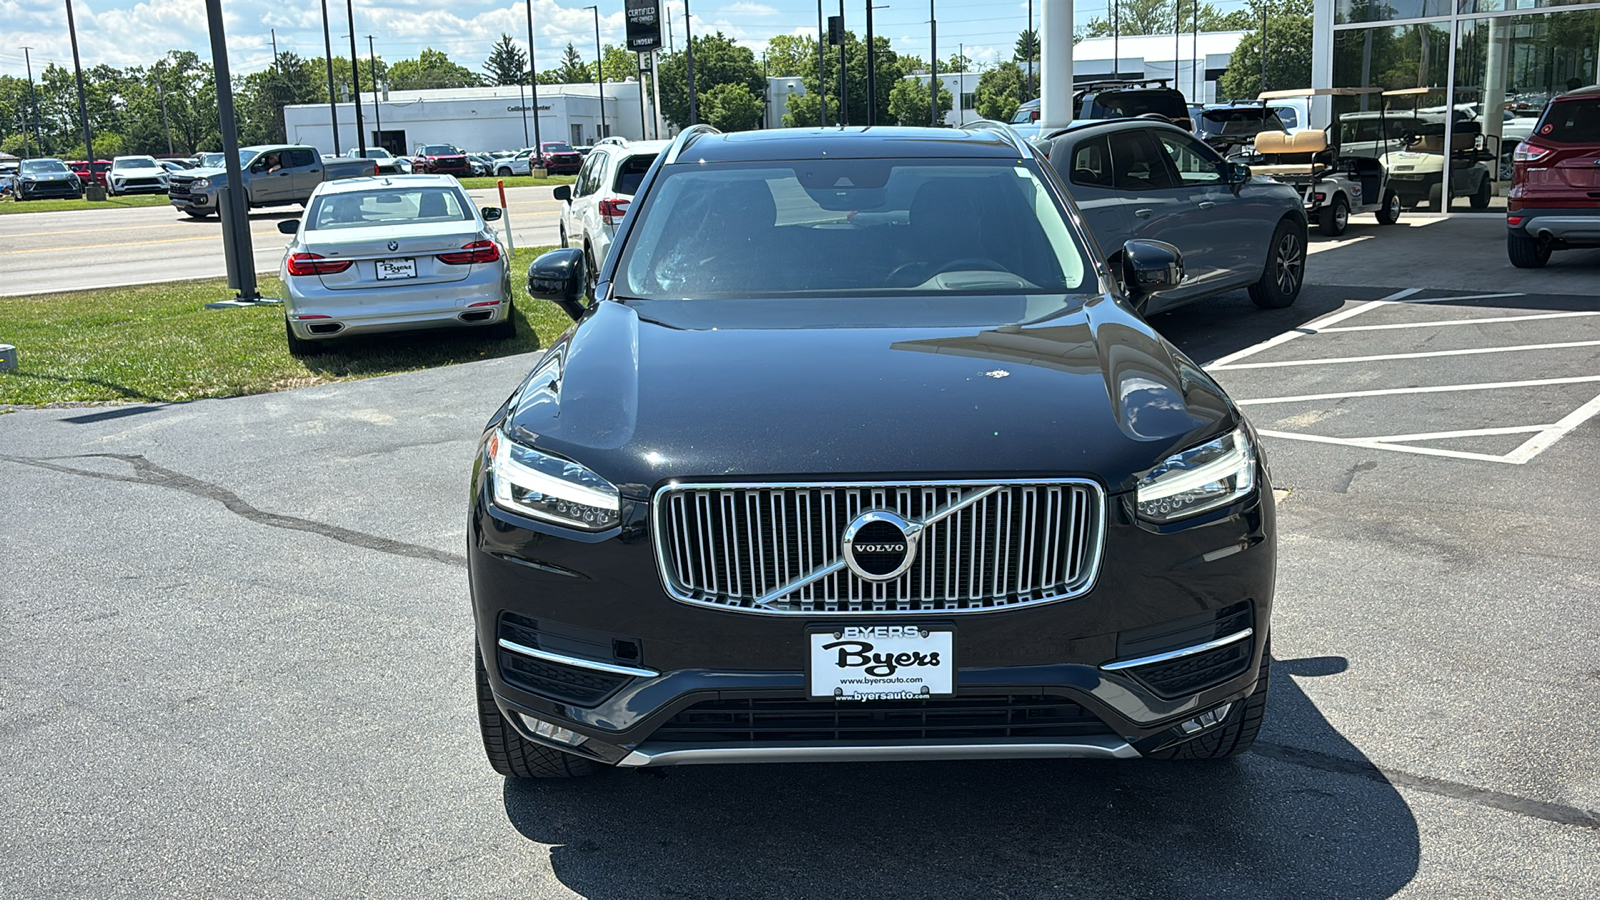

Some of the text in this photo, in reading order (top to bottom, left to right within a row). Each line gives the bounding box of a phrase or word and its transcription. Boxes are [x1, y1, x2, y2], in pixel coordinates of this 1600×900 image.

[628, 7, 655, 17] CERTIFIED
[633, 38, 653, 46] LINDSAY
[855, 544, 904, 552] VOLVO
[844, 626, 919, 639] BYERS
[821, 640, 940, 677] Byers
[840, 677, 923, 686] www.byersauto.com
[835, 690, 930, 702] www.byersauto.com
